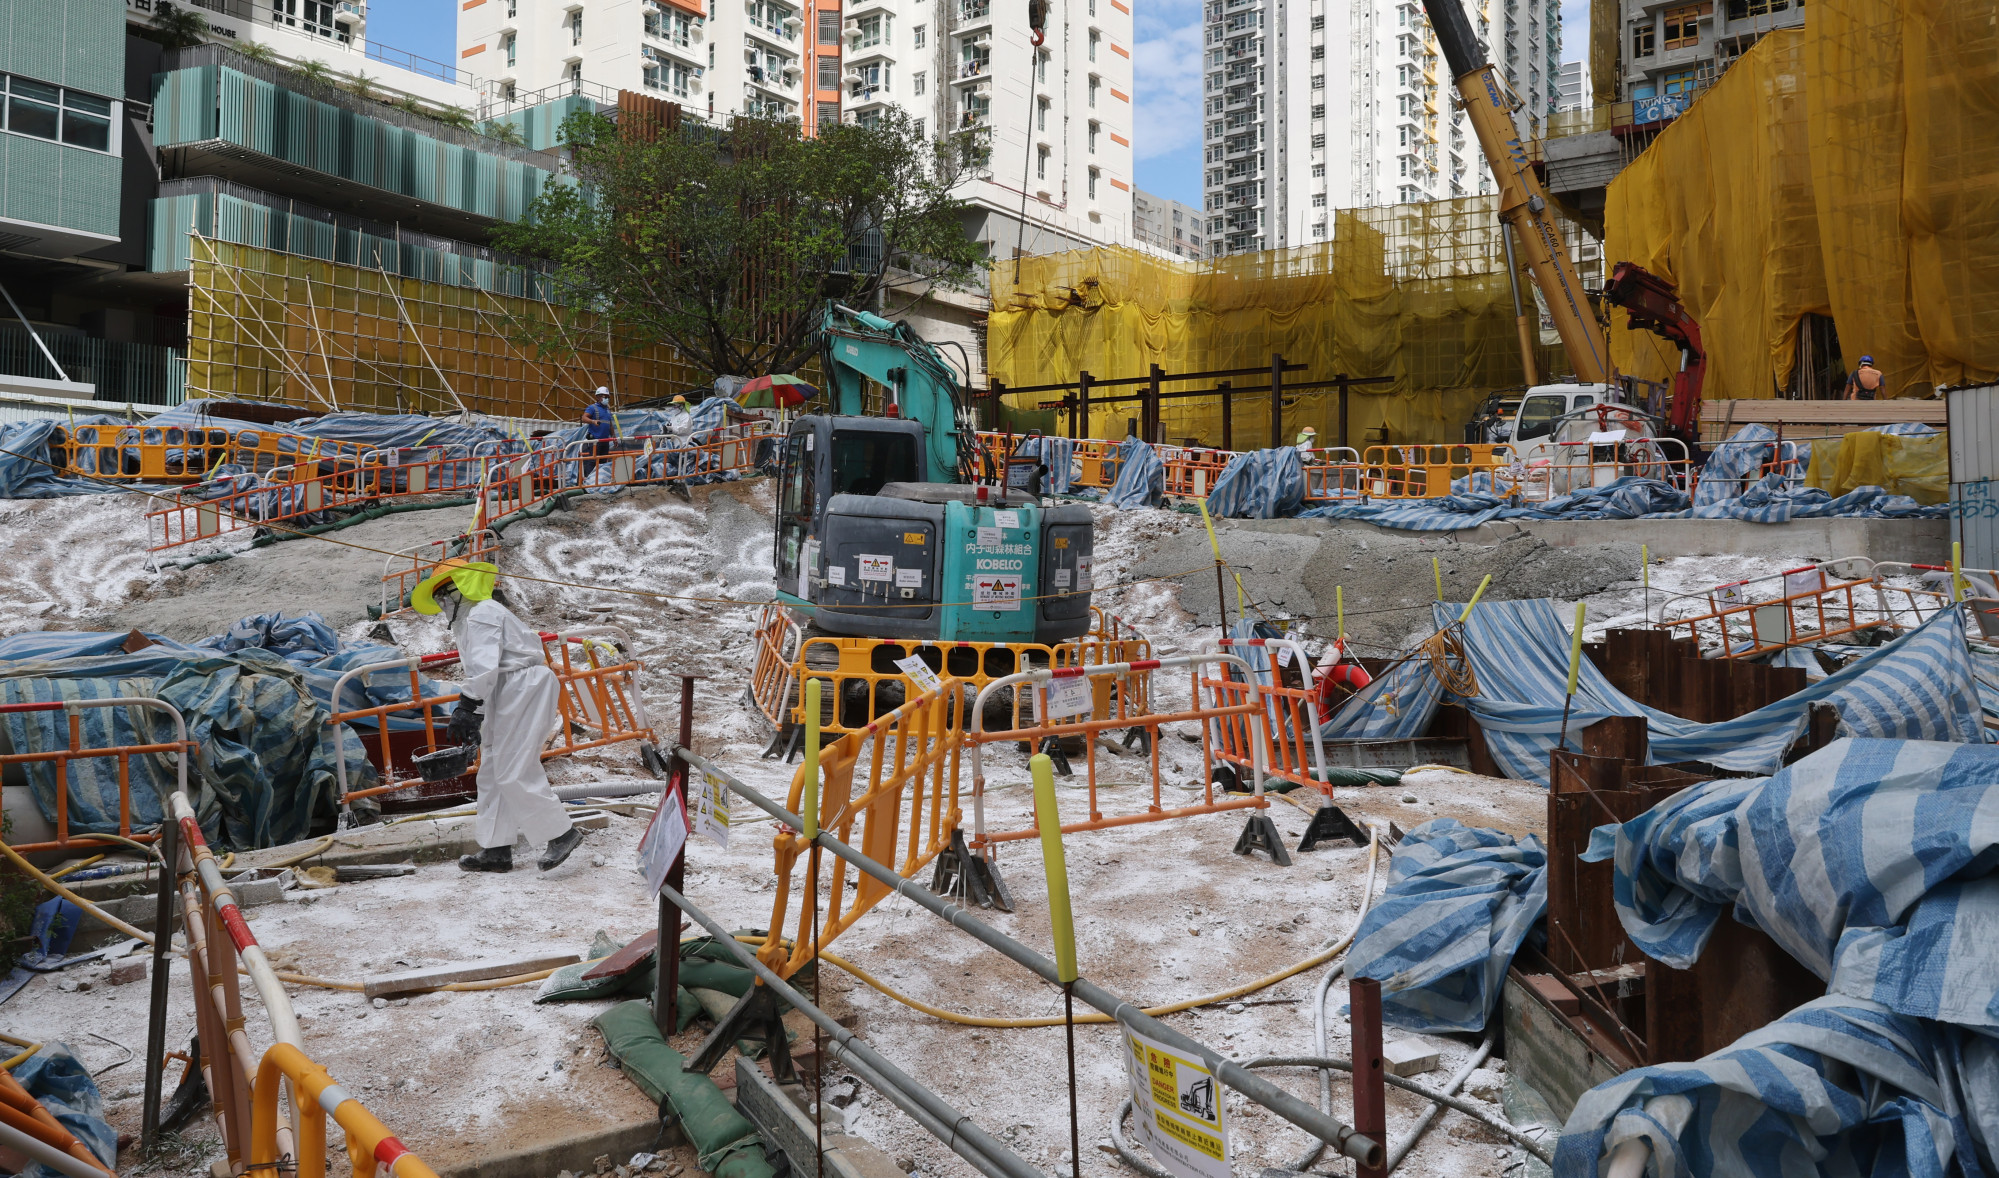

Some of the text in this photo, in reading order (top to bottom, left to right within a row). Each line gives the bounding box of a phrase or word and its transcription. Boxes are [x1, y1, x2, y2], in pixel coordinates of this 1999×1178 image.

[211, 24, 237, 39] HOUSE
[1485, 82, 1501, 108] XCMG
[1639, 96, 1671, 110] WING
[976, 558, 1023, 571] KOBELCO
[1152, 1077, 1175, 1094] DANGER
[1153, 1092, 1177, 1108] PROGRESS
